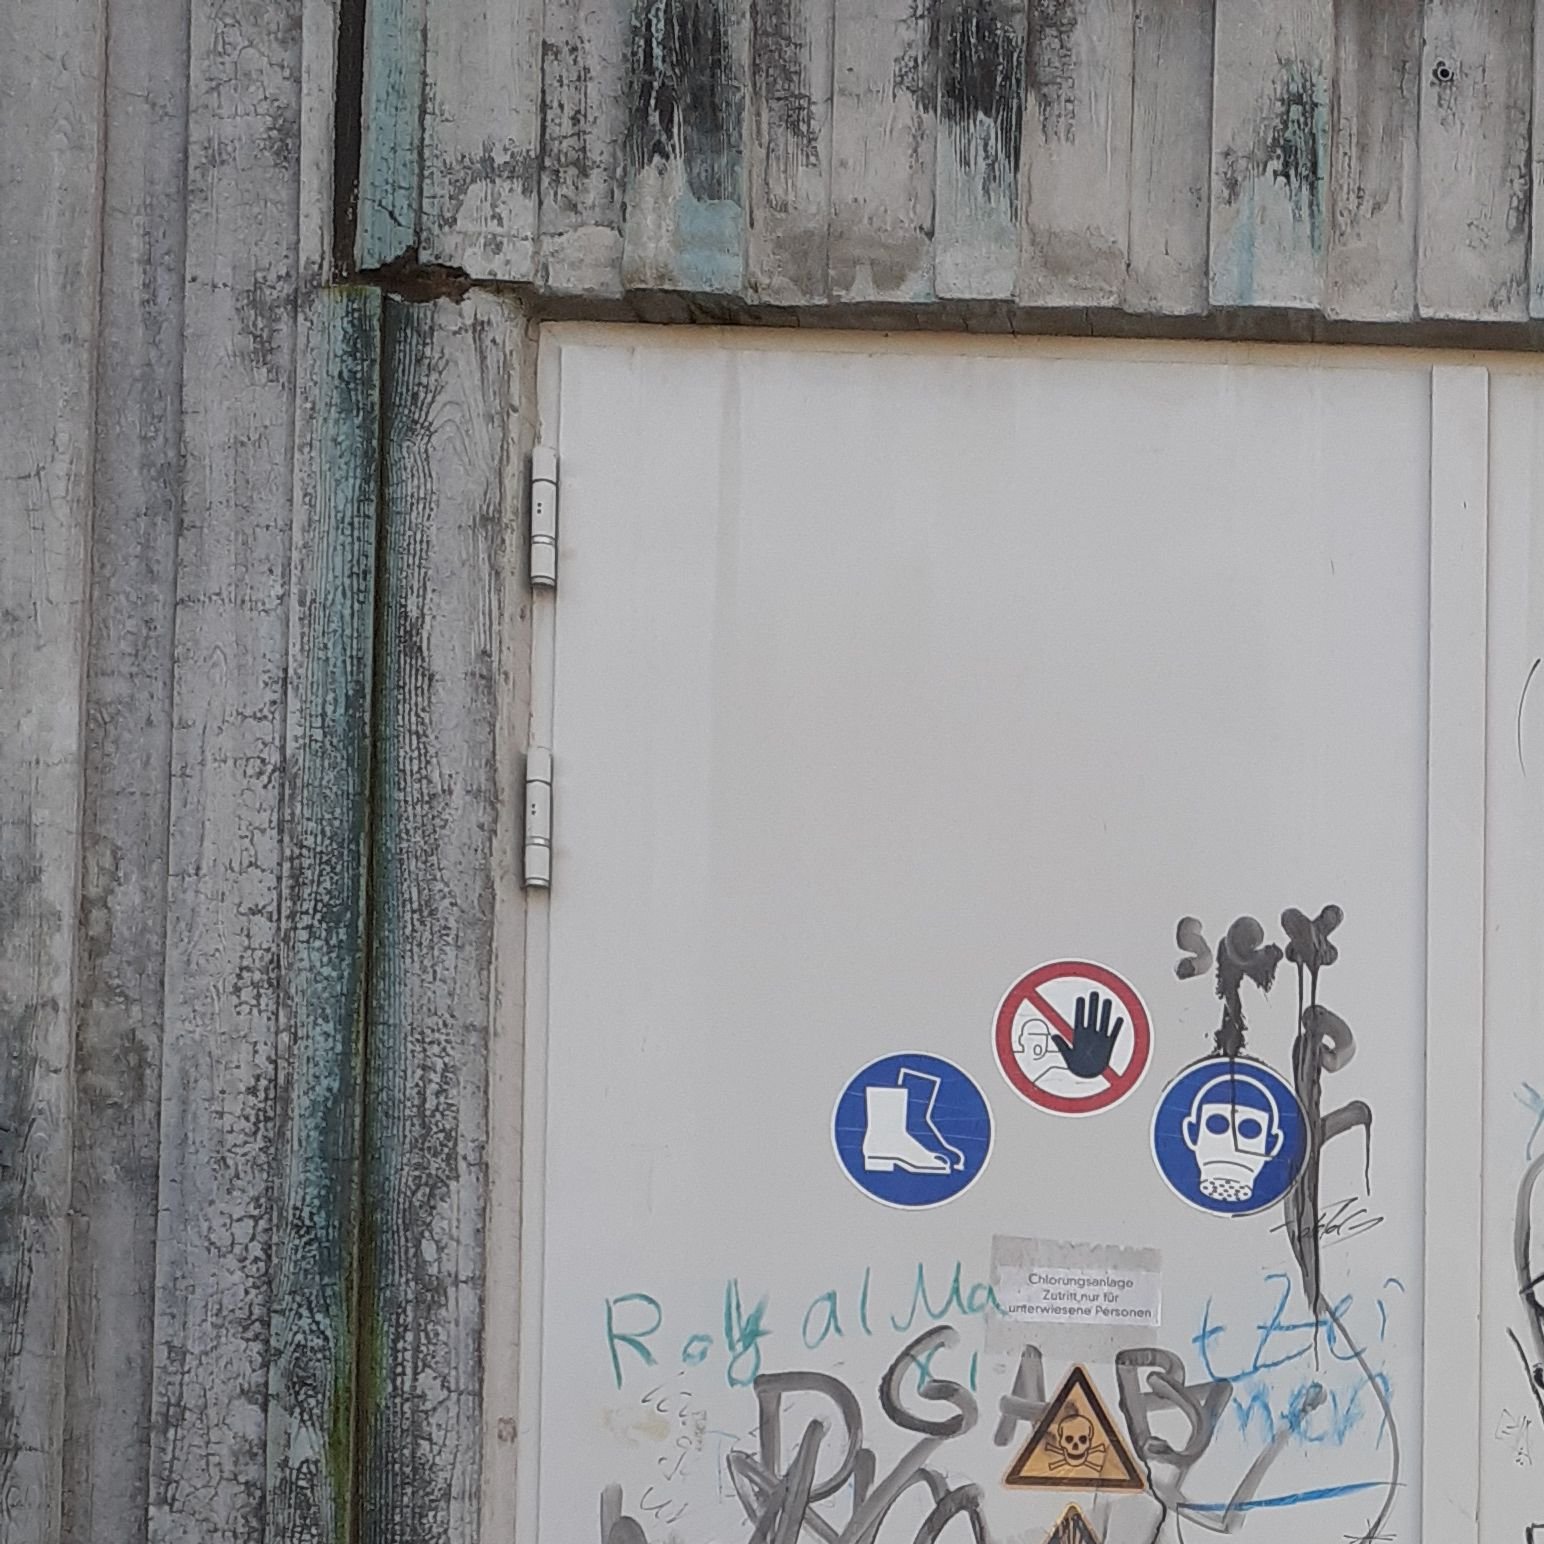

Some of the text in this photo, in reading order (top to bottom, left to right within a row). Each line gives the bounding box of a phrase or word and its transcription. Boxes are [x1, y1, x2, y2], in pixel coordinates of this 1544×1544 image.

[1028, 1272, 1134, 1290] Chlorungsanlage
[1042, 1289, 1119, 1303] Zutritt nur für
[1008, 1303, 1152, 1318] unterwiesene Personen
